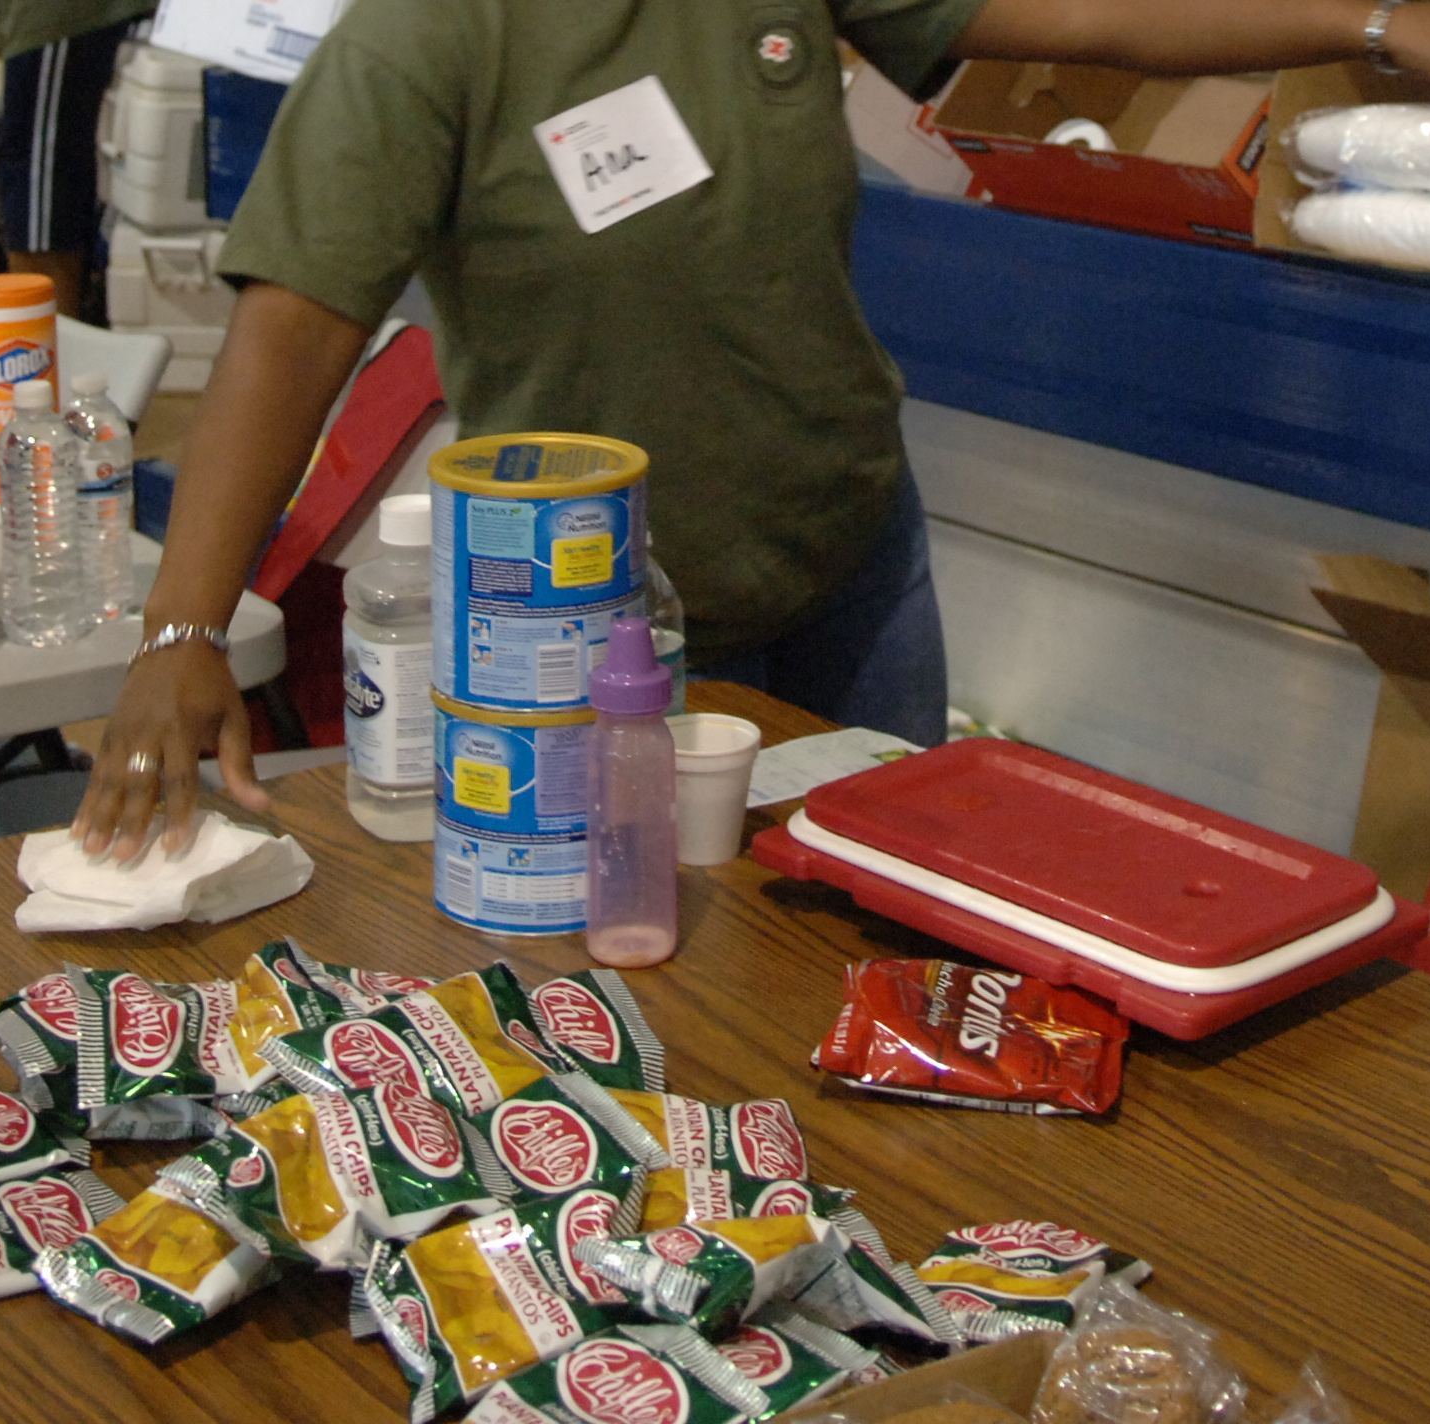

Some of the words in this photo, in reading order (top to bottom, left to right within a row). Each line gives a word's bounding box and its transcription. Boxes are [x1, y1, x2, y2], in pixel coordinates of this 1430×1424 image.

[425, 1004, 486, 1080] PLATANITOS
[431, 1035, 485, 1115] PLANTAIN
[328, 1091, 355, 1135] NTAIN
[346, 1139, 374, 1197] CHIPS
[684, 1098, 705, 1141] ANTAIN
[708, 1169, 728, 1220] PLANTAI
[537, 1288, 575, 1338] CHIPS
